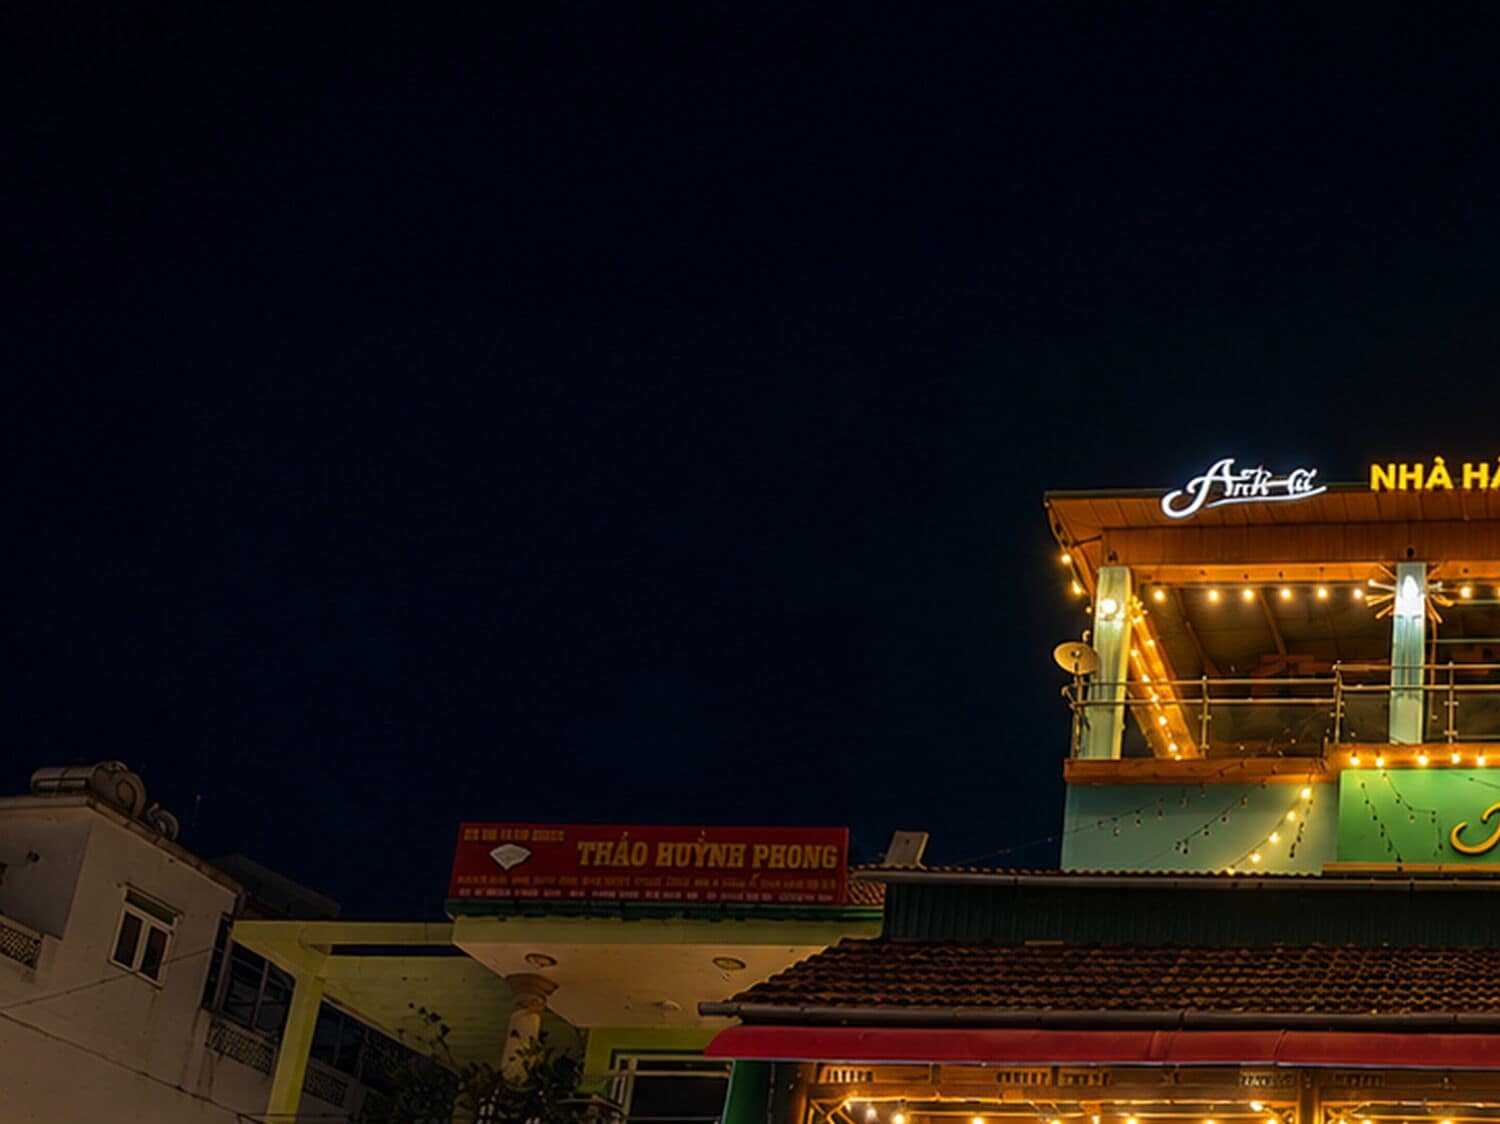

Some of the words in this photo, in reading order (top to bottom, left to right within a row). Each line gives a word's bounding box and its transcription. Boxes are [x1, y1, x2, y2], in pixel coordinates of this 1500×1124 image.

[1370, 456, 1454, 491] NHÀ
[577, 830, 649, 868] THẢO
[751, 843, 840, 871] PHONG
